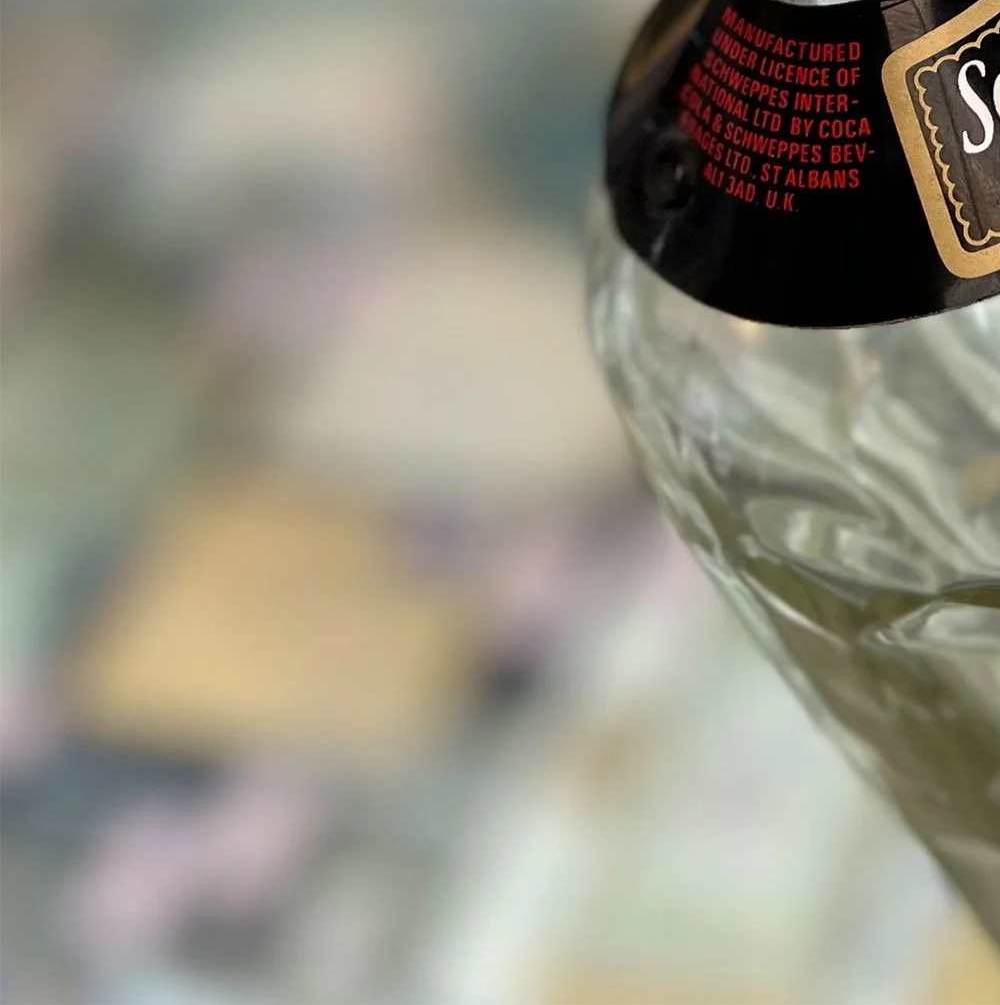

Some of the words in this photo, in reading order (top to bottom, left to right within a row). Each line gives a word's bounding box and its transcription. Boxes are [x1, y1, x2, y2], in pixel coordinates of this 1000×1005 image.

[712, 28, 758, 70] UNDER
[759, 56, 830, 87] LICENCE
[836, 67, 861, 87] OF
[721, 6, 861, 63] MANUFACTURED
[703, 49, 789, 109] SCHWEPPES
[793, 92, 860, 113] INTER-
[711, 113, 723, 133] &
[724, 122, 823, 163] SCHWEPPES
[830, 142, 876, 164] BEV-
[752, 108, 782, 133] LTD
[790, 116, 815, 138] BY
[818, 117, 872, 139] COCA
[760, 163, 783, 185] ST
[784, 168, 861, 189] ALBANS
